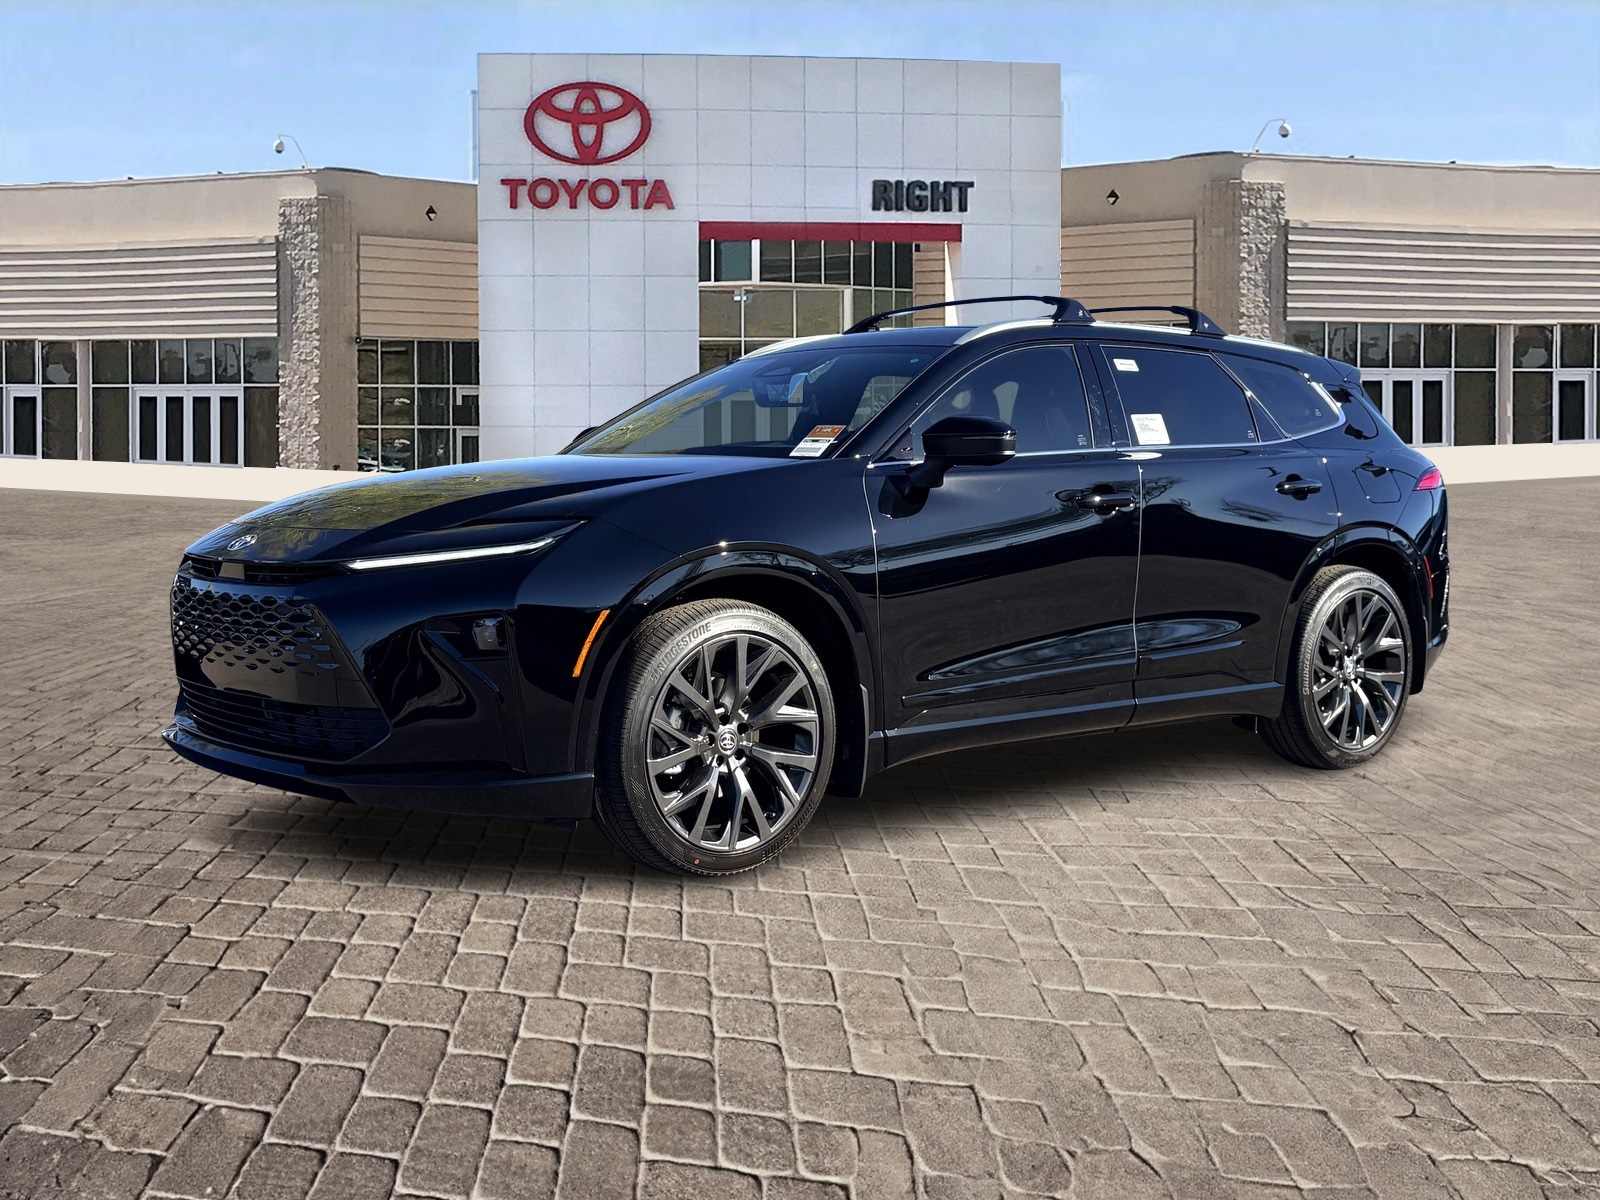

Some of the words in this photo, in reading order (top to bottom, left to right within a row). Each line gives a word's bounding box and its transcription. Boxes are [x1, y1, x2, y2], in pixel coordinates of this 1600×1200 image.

[500, 177, 676, 210] TOYOTA
[871, 179, 975, 212] RIGHT
[650, 621, 713, 685] BRIDGESTONE
